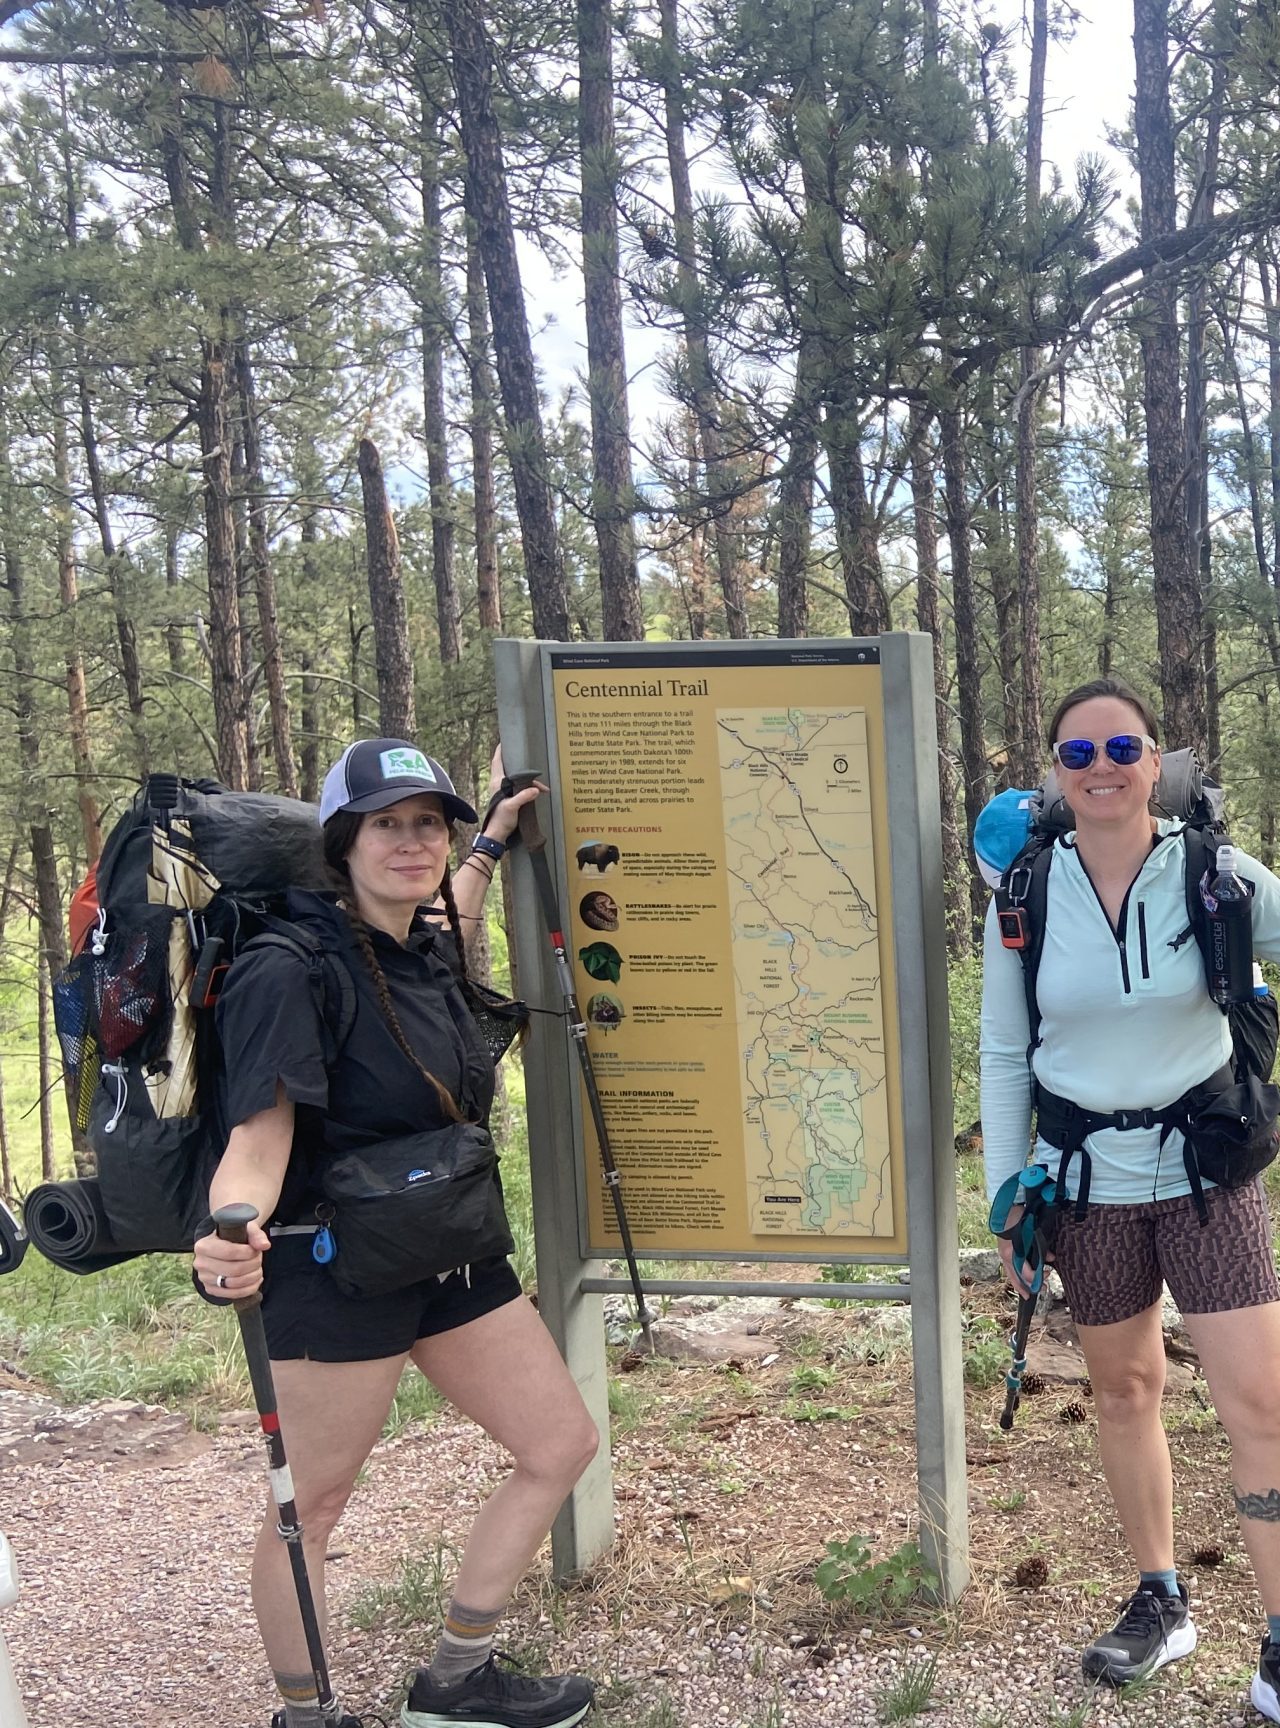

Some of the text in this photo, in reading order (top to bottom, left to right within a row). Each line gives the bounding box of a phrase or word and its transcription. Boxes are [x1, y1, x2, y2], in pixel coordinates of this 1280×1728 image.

[566, 680, 708, 697] Centennial Trail
[1214, 922, 1223, 970] essentia
